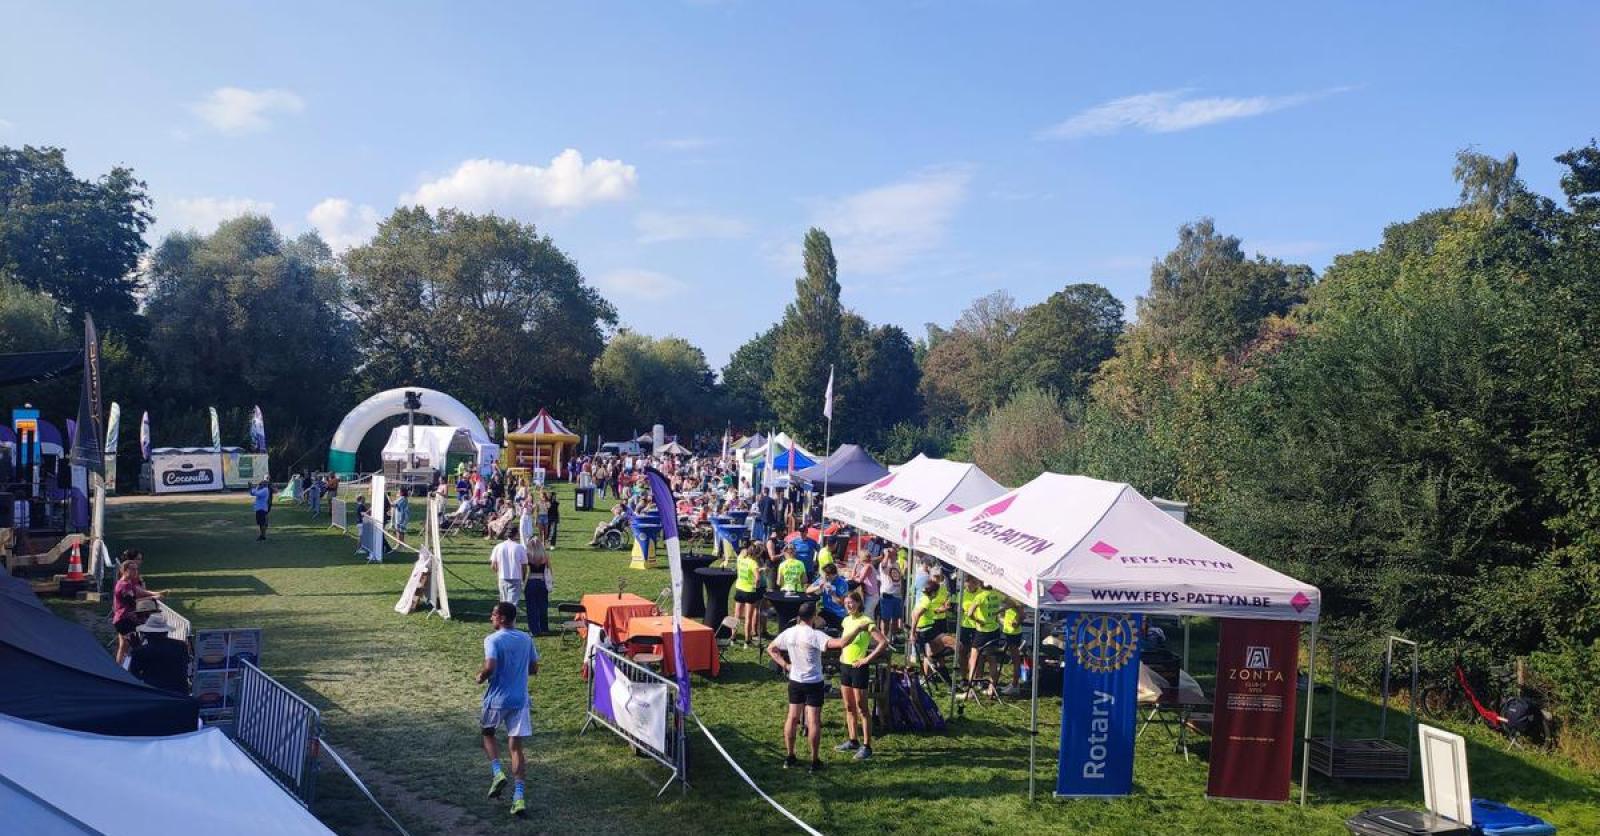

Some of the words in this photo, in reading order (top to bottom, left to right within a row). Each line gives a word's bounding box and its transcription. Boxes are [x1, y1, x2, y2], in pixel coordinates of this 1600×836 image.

[967, 520, 1055, 555] FEYS-PATTYN
[1120, 556, 1234, 569] FEYS-PATTYN
[1091, 588, 1271, 608] WWW.FEYS-PATTYN.BE
[1229, 668, 1284, 682] ZONTA
[1082, 690, 1115, 779] Rotary
